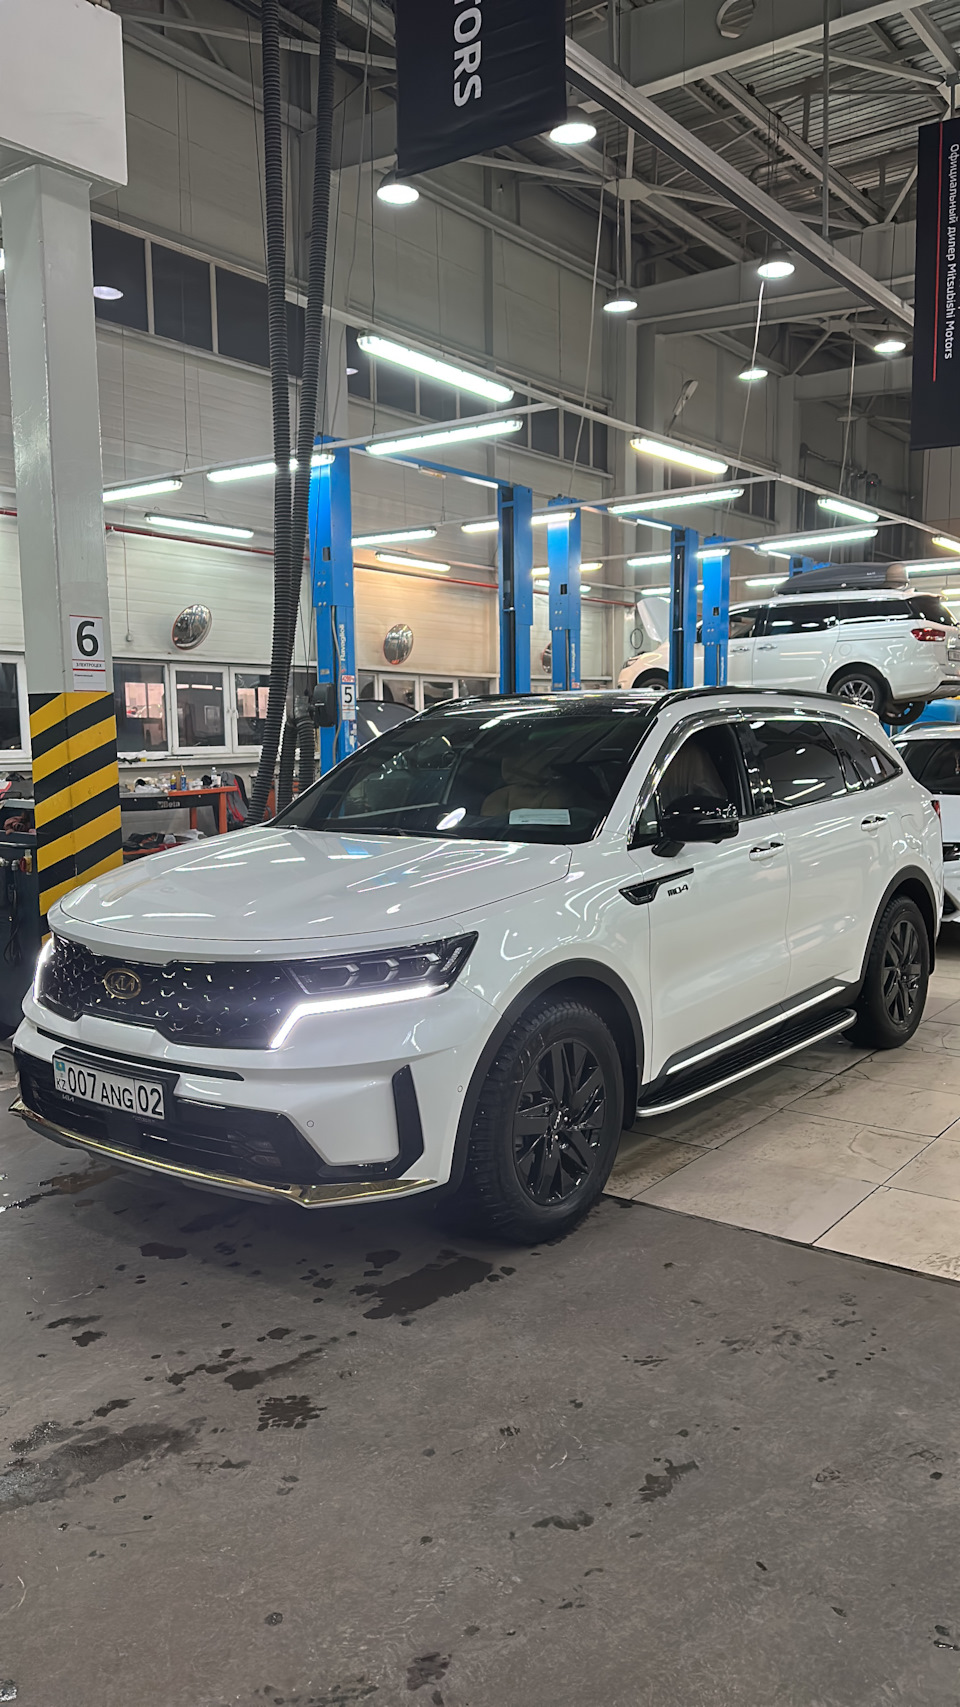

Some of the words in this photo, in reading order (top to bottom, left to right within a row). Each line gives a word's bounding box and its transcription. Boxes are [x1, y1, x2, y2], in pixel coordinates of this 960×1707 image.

[453, 0, 482, 107] ORS
[948, 143, 960, 224] Официальный
[945, 226, 957, 261] дилер
[945, 263, 957, 319] Mitsubishi
[944, 320, 955, 360] Motors
[76, 620, 99, 657] 6
[344, 686, 353, 704] 5
[56, 1077, 67, 1091] KZ
[68, 1067, 97, 1099] 007
[100, 1081, 134, 1110] ANG
[137, 1084, 163, 1116] 02
